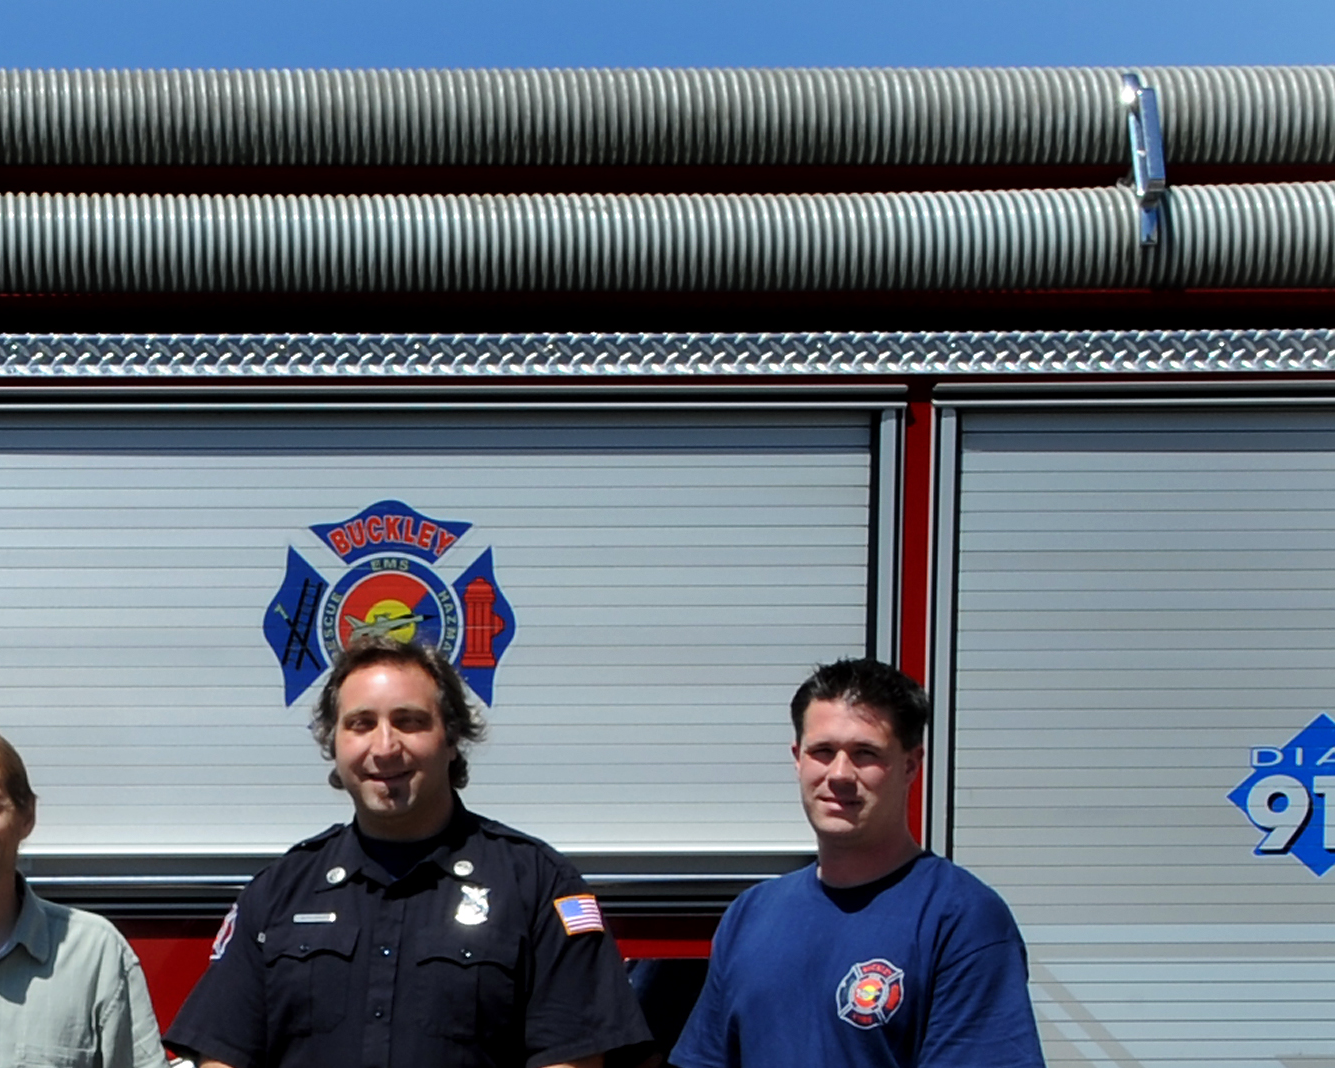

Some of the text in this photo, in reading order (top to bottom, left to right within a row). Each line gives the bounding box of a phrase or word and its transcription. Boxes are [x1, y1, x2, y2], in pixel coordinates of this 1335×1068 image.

[327, 515, 458, 557] BUCKLEY
[370, 559, 410, 571] EMS
[438, 590, 457, 655] HAZMA
